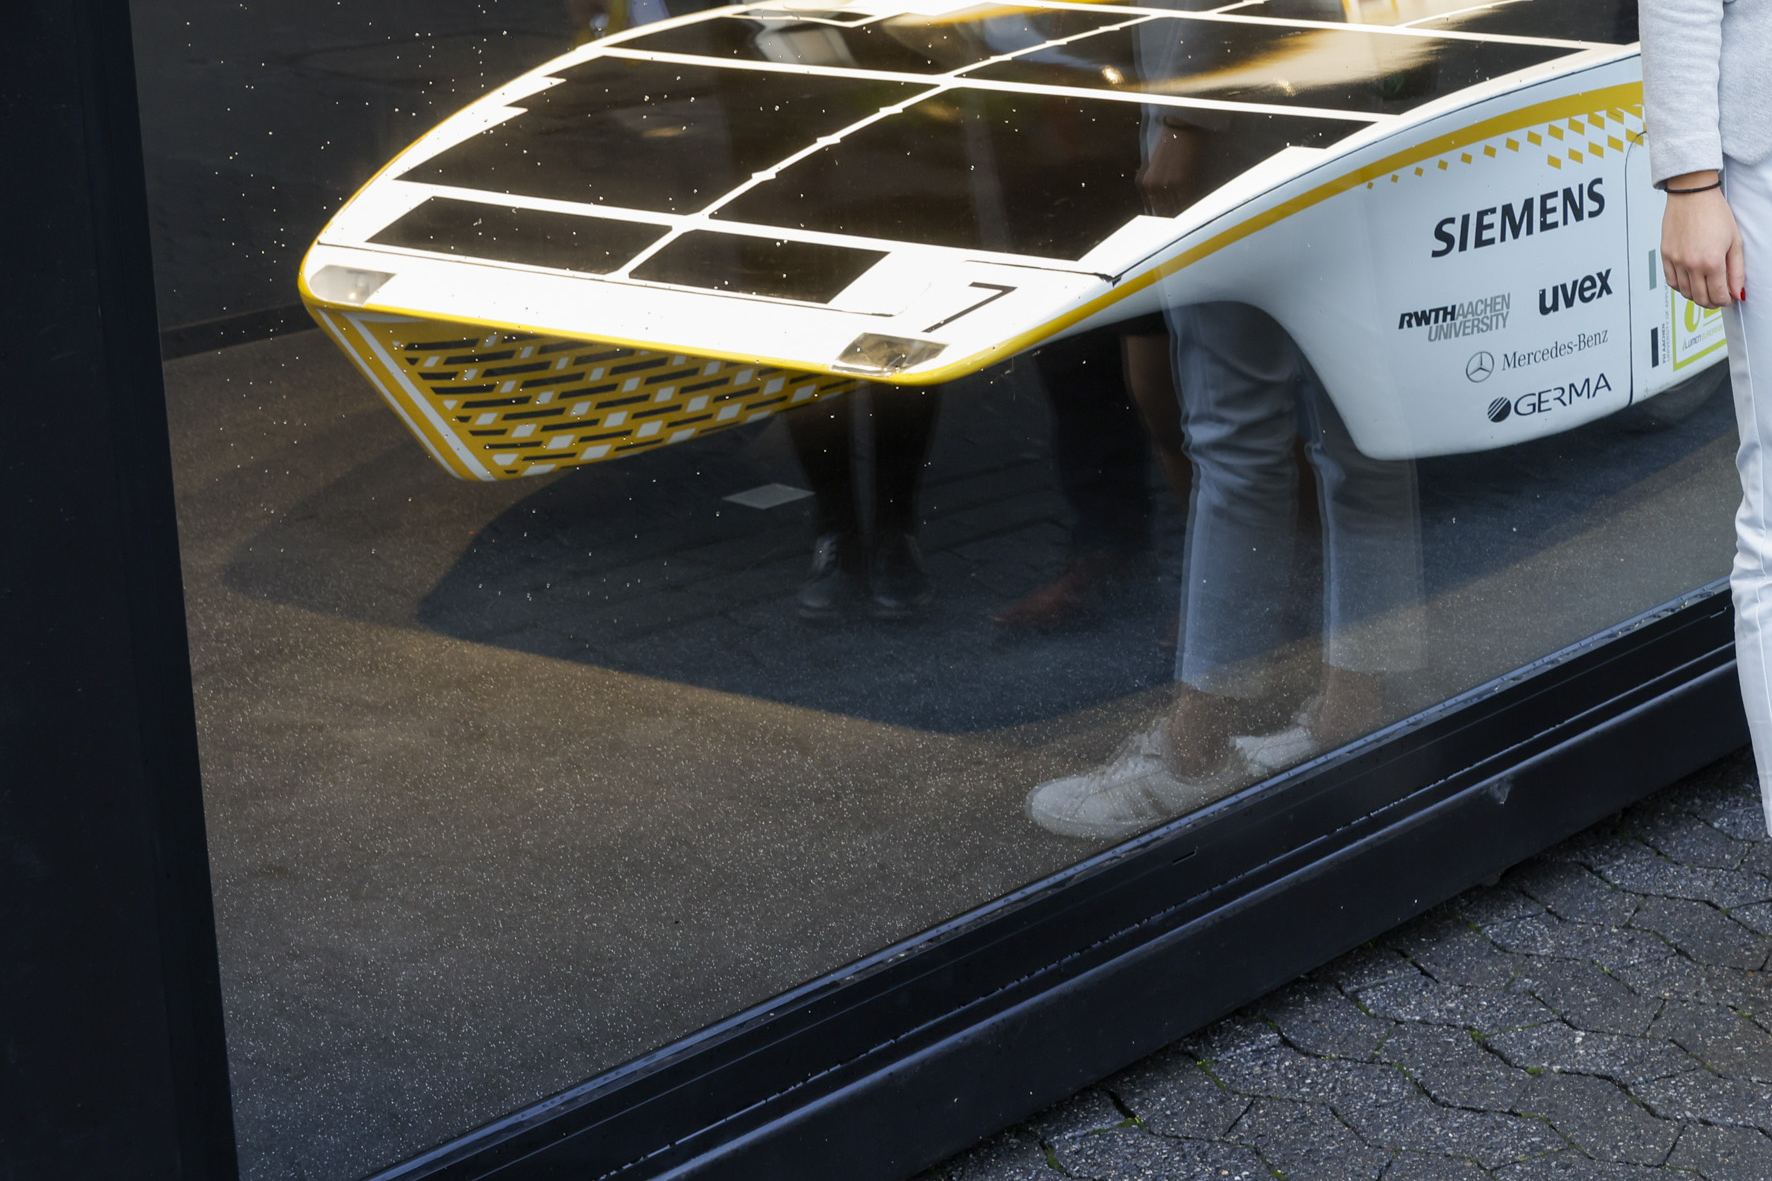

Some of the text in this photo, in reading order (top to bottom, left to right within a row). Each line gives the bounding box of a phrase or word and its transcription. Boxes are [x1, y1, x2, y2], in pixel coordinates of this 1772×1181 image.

[1431, 178, 1605, 258] SIEMENS
[1538, 268, 1613, 316] uvex
[1428, 311, 1510, 343] UNIVERSITY
[1501, 329, 1609, 372] Mercedes-Benz
[1513, 372, 1613, 417] GERMA
